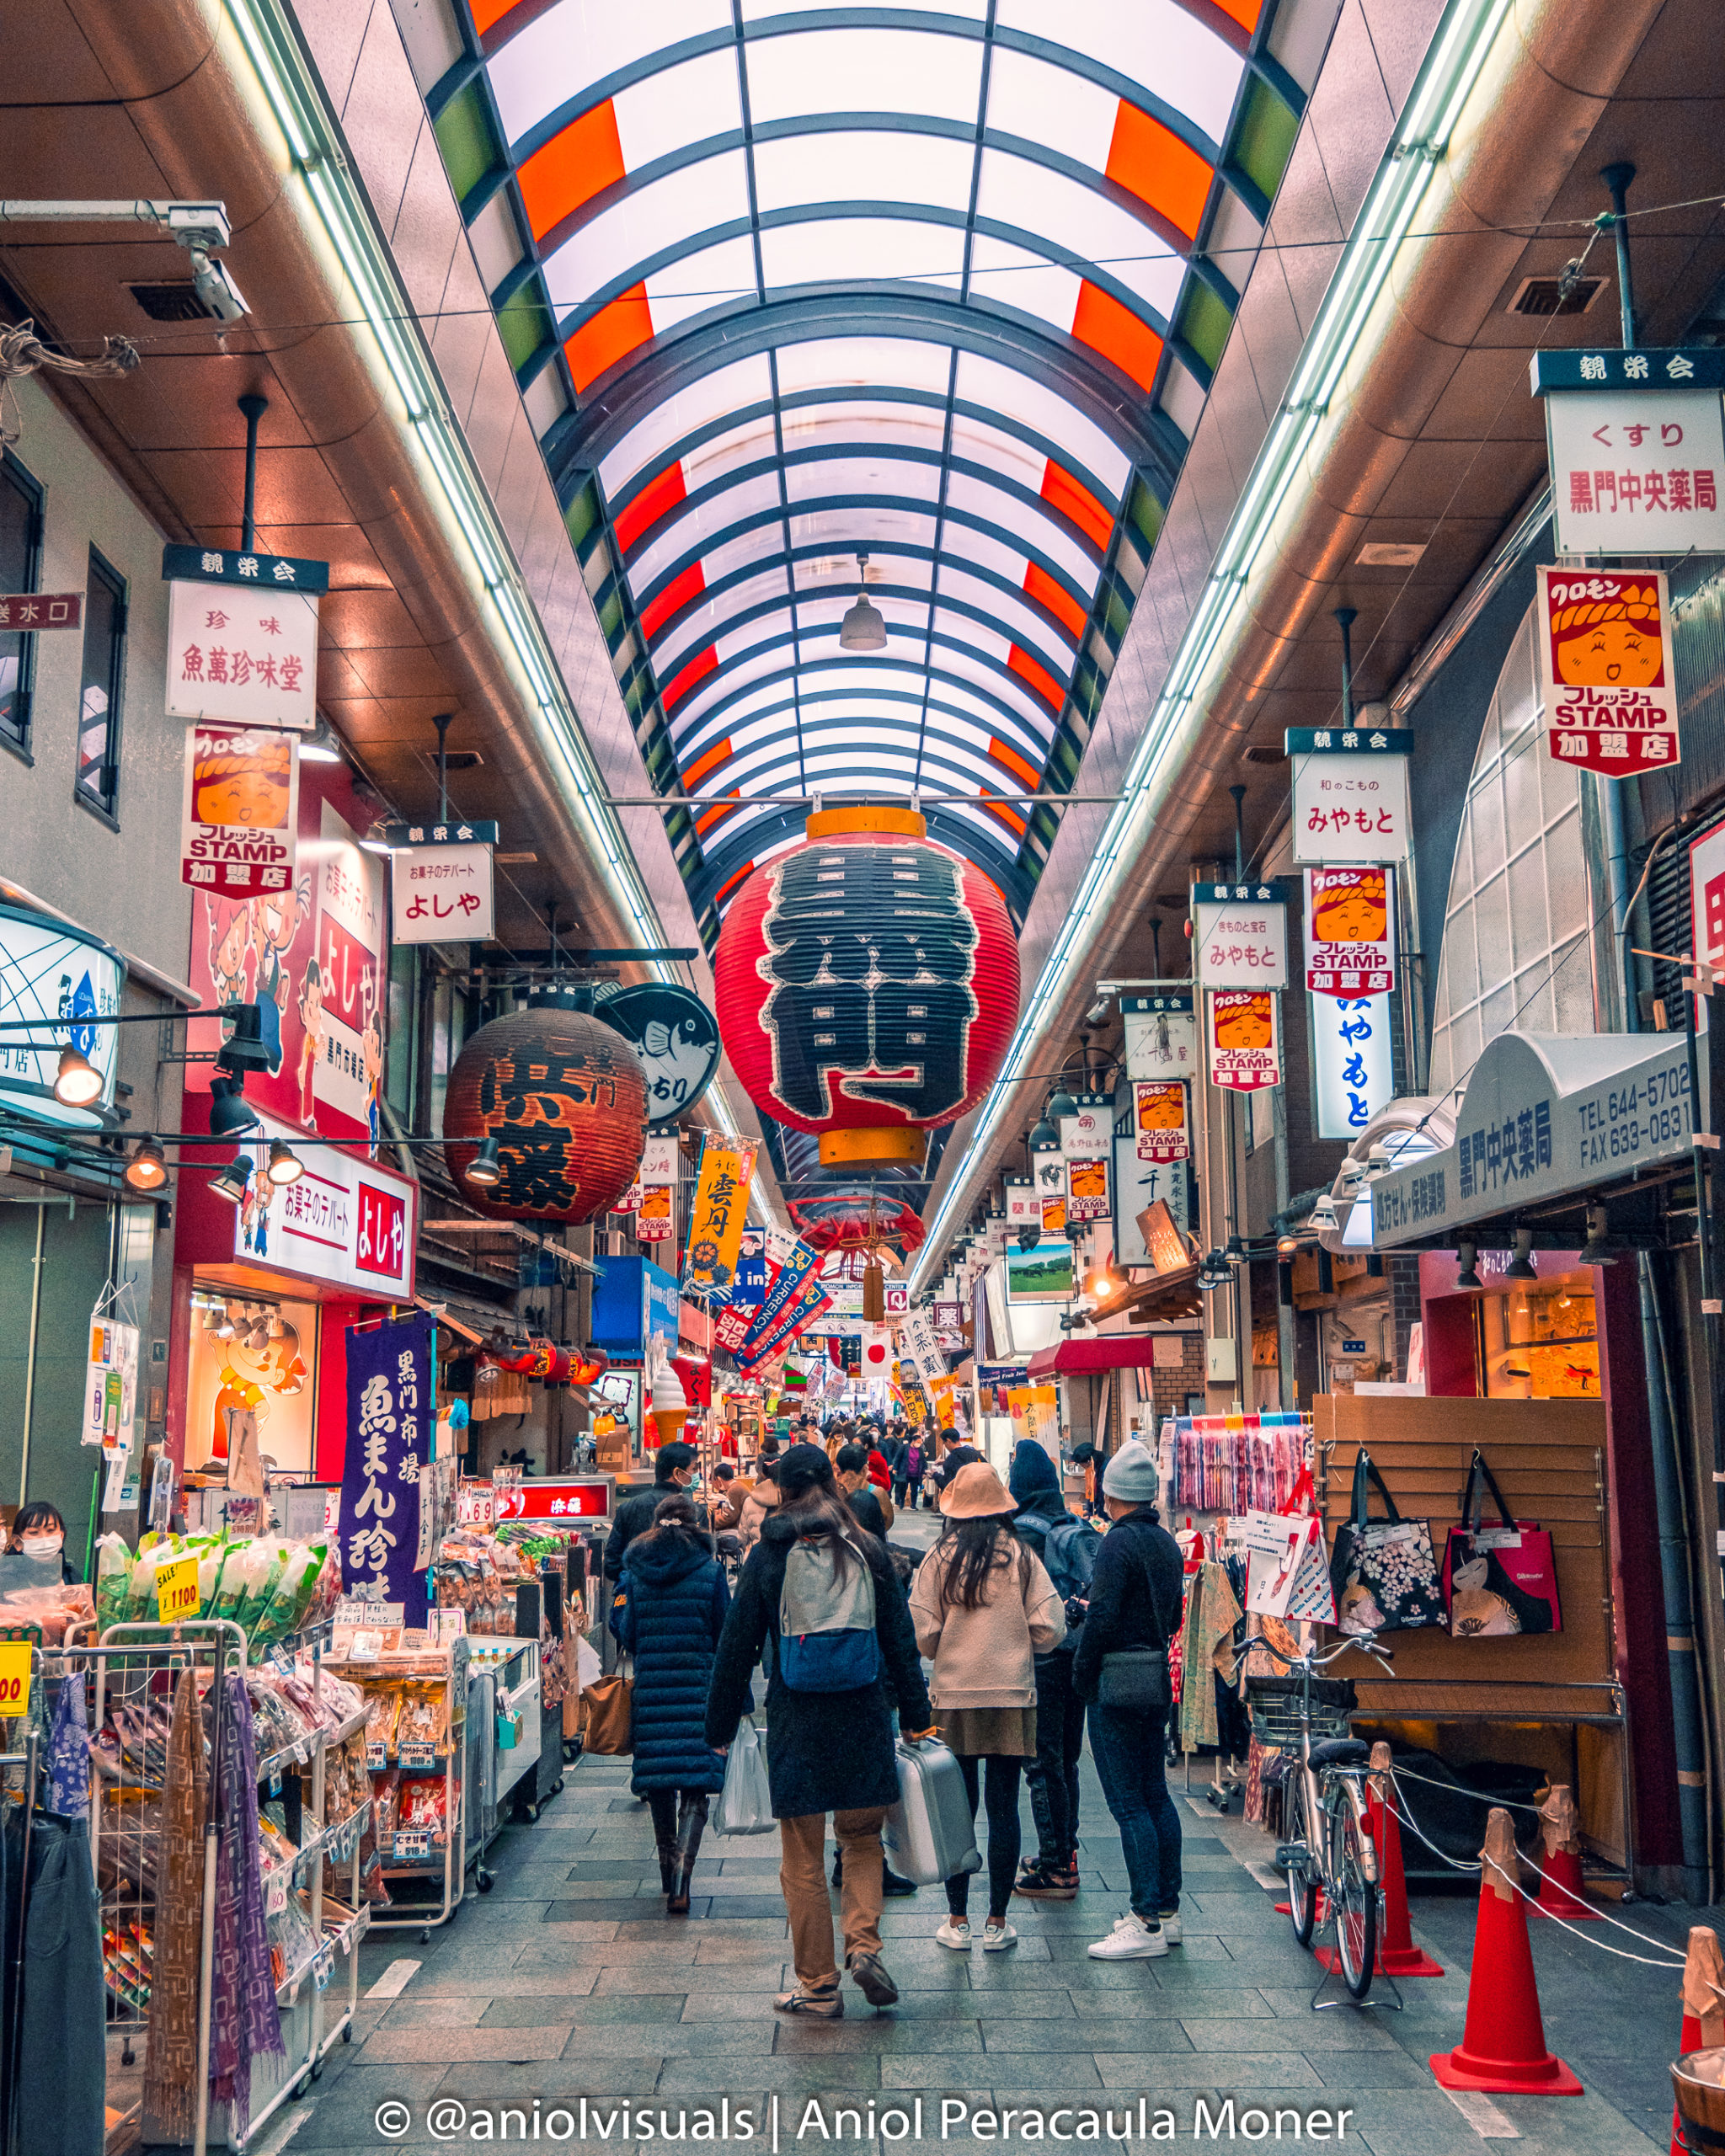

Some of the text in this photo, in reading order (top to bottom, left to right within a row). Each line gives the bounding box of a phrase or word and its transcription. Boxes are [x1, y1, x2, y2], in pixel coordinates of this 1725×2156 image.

[1580, 355, 1694, 379] 親栄会
[1592, 424, 1684, 448] くすり
[1569, 468, 1717, 513] 黒門中央薬局
[201, 552, 296, 582] 親栄会
[205, 610, 282, 635] 珍味
[181, 643, 304, 693] 魚萬珍味堂
[1564, 686, 1653, 707] フレッシュ
[1556, 706, 1667, 729] STAMP
[1314, 731, 1388, 750] 親栄会
[1558, 732, 1669, 759] 加盟店
[1319, 779, 1380, 792] 和のこもの
[1308, 806, 1394, 834] みやもと
[199, 825, 276, 845] フレッシュ
[409, 825, 473, 841] 親栄会
[190, 839, 287, 862] STAMP
[190, 861, 286, 888] 加盟店
[1215, 885, 1271, 899] 親栄会
[405, 892, 481, 920] よしや
[1210, 944, 1276, 968] みやもと
[1318, 942, 1379, 955] フレッシュ
[1312, 953, 1387, 969] STAMP
[321, 928, 374, 1027] よしや
[1312, 973, 1388, 990] 加盟店
[1216, 1058, 1273, 1070] STAMP
[1220, 1049, 1266, 1059] フレッシュ
[1217, 1070, 1274, 1084] 加盟店
[1579, 1061, 1690, 1134] TEL 644-5702
[1140, 1136, 1185, 1146] STAMP
[1580, 1102, 1690, 1169] FAX 633-0831
[1140, 1147, 1188, 1158] 加盟店
[1459, 1099, 1552, 1199] 黒門中央薬局
[285, 1182, 350, 1237] お菓子のデパート
[359, 1195, 403, 1270] よしや
[753, 1273, 798, 1334] CURRENCY
[398, 1349, 420, 1485] 黒門市場
